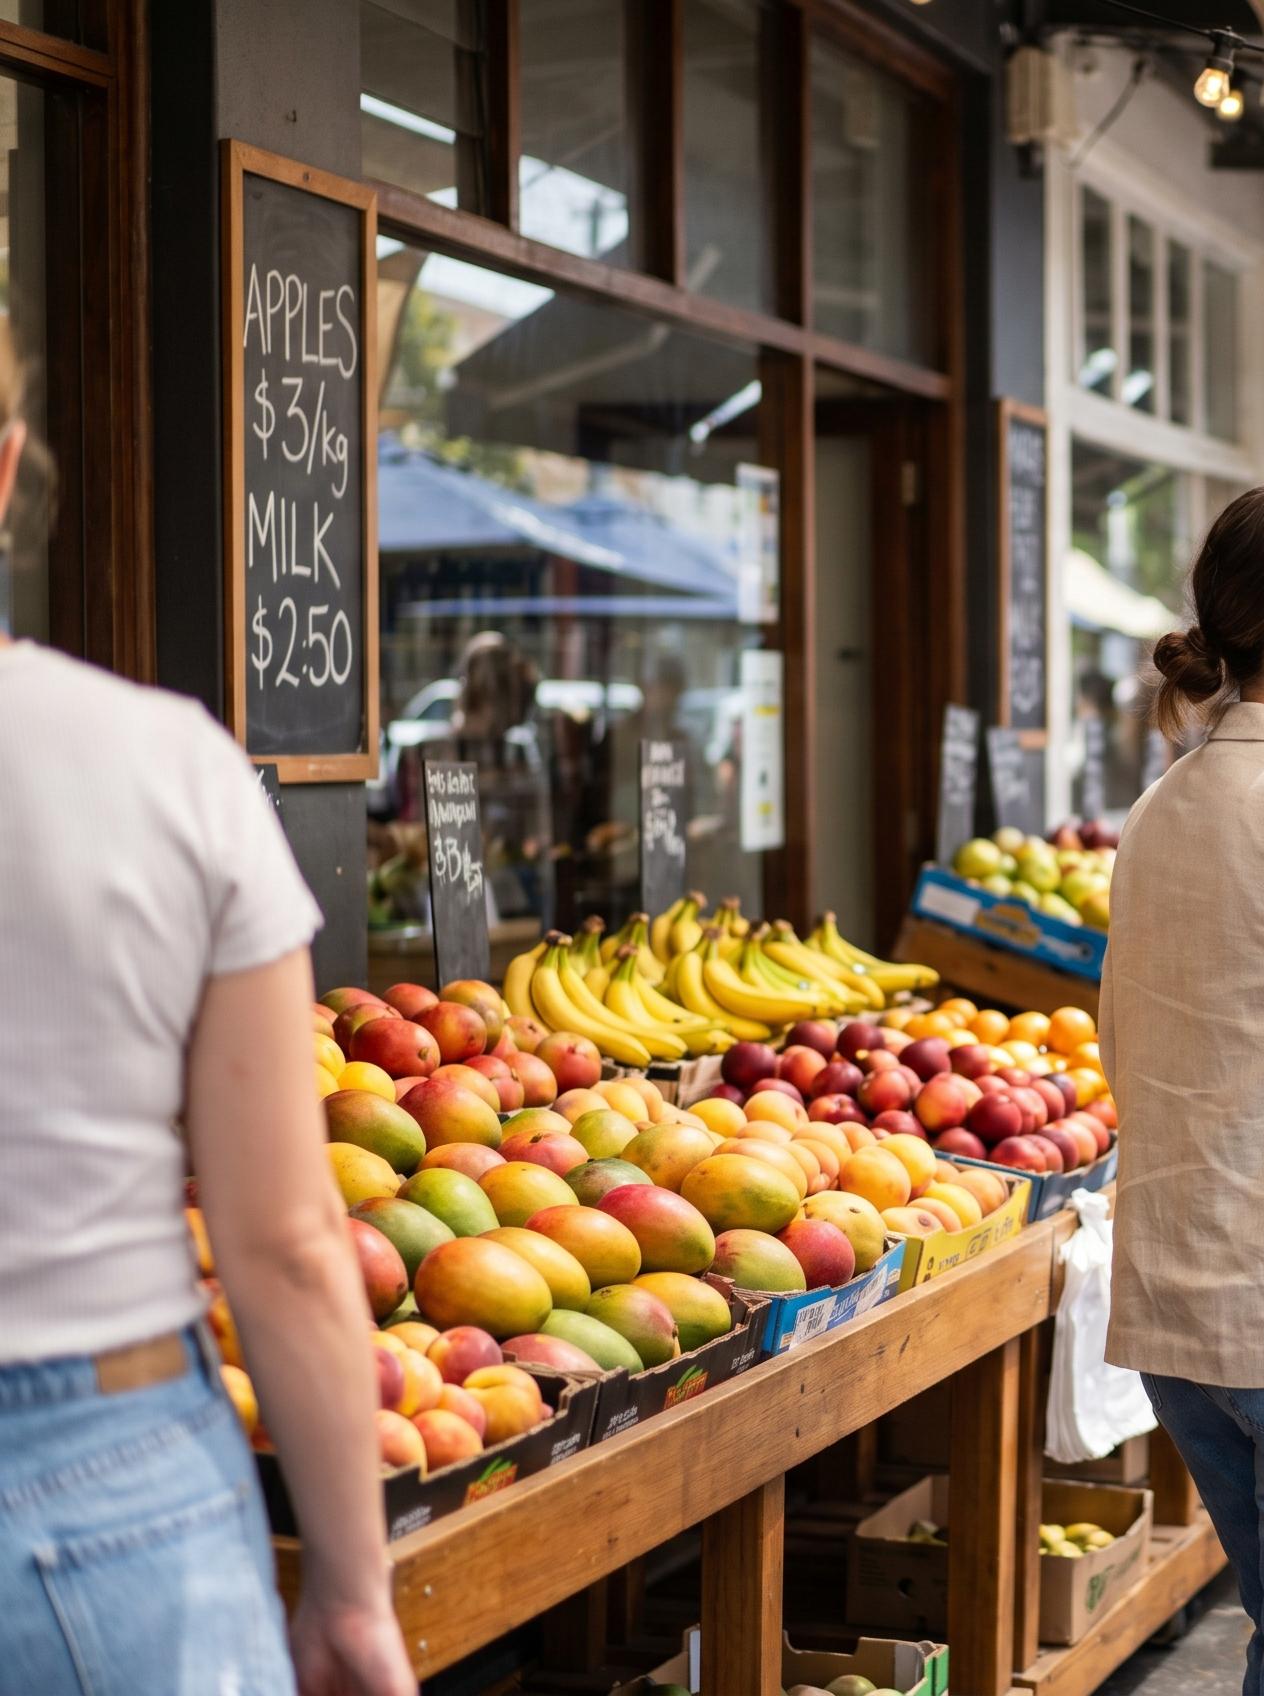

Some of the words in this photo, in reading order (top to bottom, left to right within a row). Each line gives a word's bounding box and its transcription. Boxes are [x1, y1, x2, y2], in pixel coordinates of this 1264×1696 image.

[243, 262, 357, 379] APPLES
[253, 368, 348, 498] $3/kg
[249, 490, 341, 589] MILK
